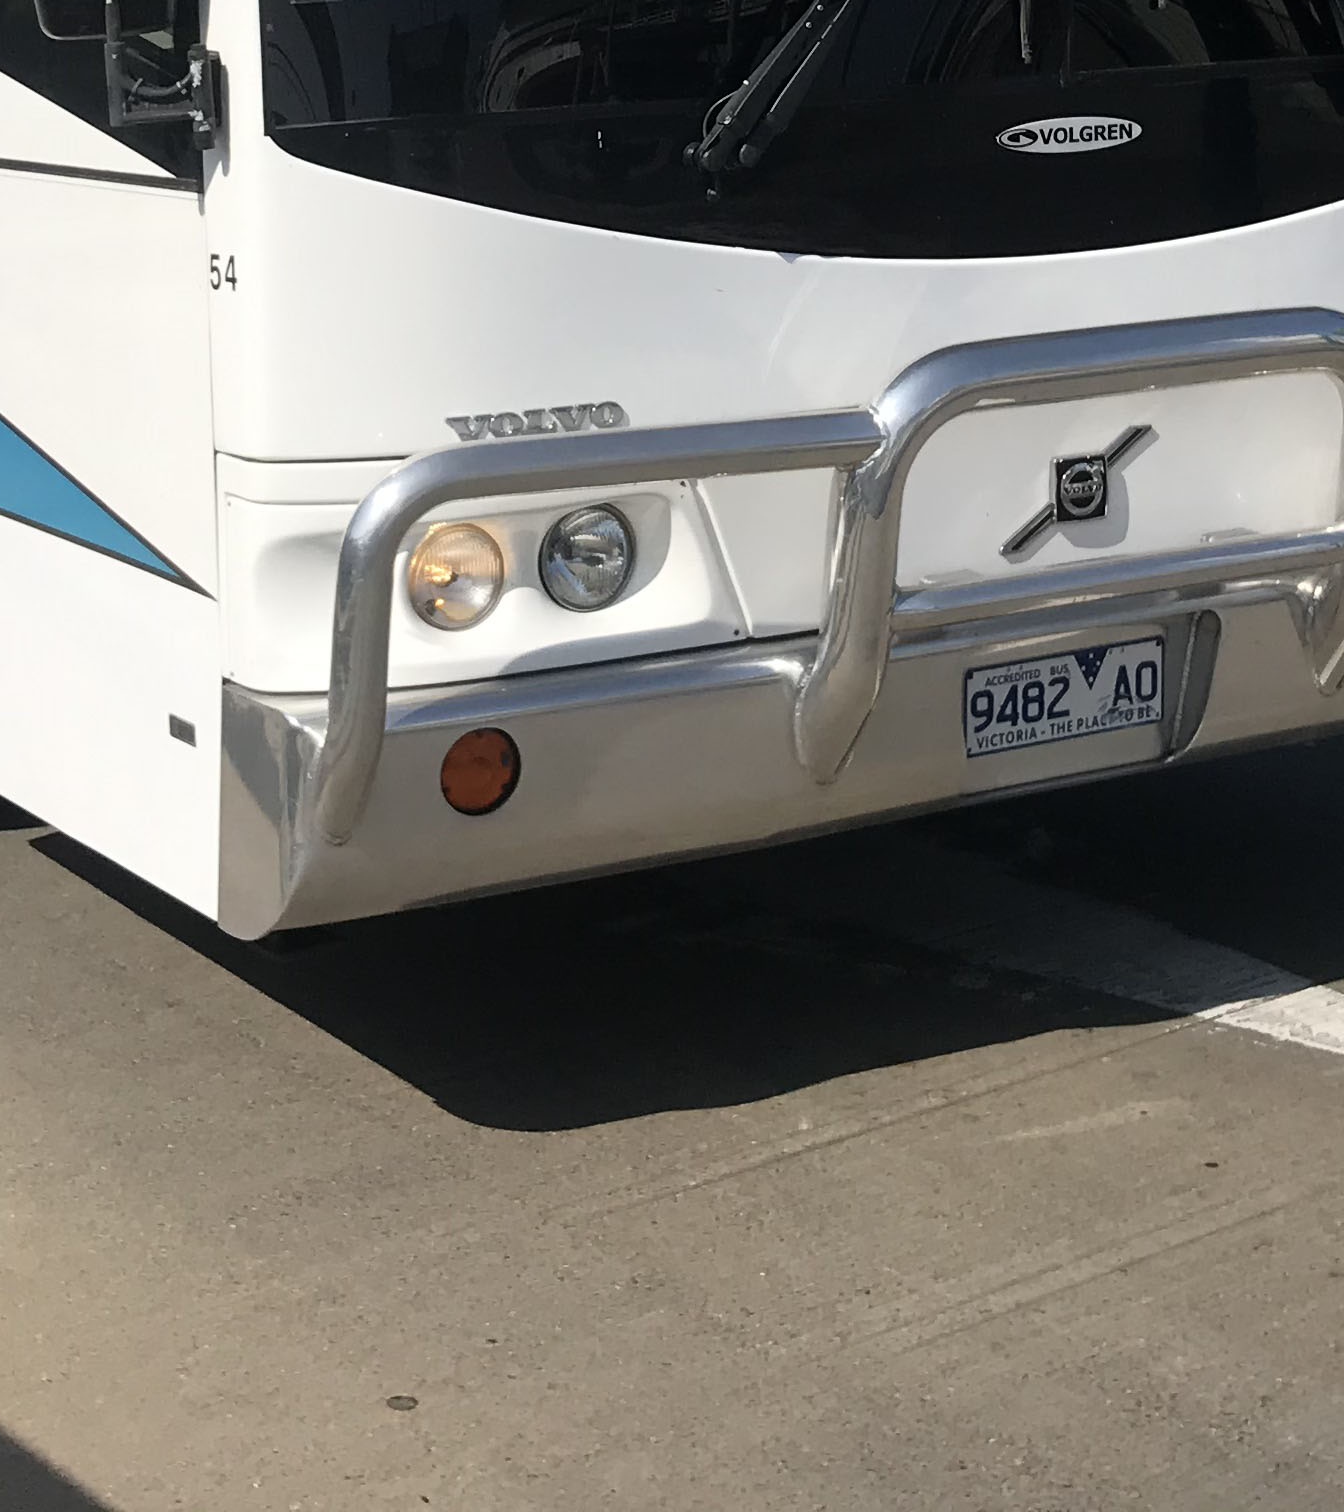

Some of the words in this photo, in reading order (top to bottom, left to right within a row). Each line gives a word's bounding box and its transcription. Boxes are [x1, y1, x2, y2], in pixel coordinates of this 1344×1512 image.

[1038, 123, 1133, 145] VOLGREN
[210, 253, 238, 292] 54
[445, 401, 628, 442] VOLVO
[1063, 482, 1103, 496] VOLVO
[985, 669, 1042, 687] ACCREDITED
[1049, 663, 1069, 676] BUS
[969, 676, 1071, 734] 9482
[1112, 660, 1157, 706] AO
[976, 727, 1038, 750] VICTORIA
[1050, 720, 1073, 735] THE
[1076, 713, 1114, 730] PLAC
[1137, 704, 1152, 720] BE
